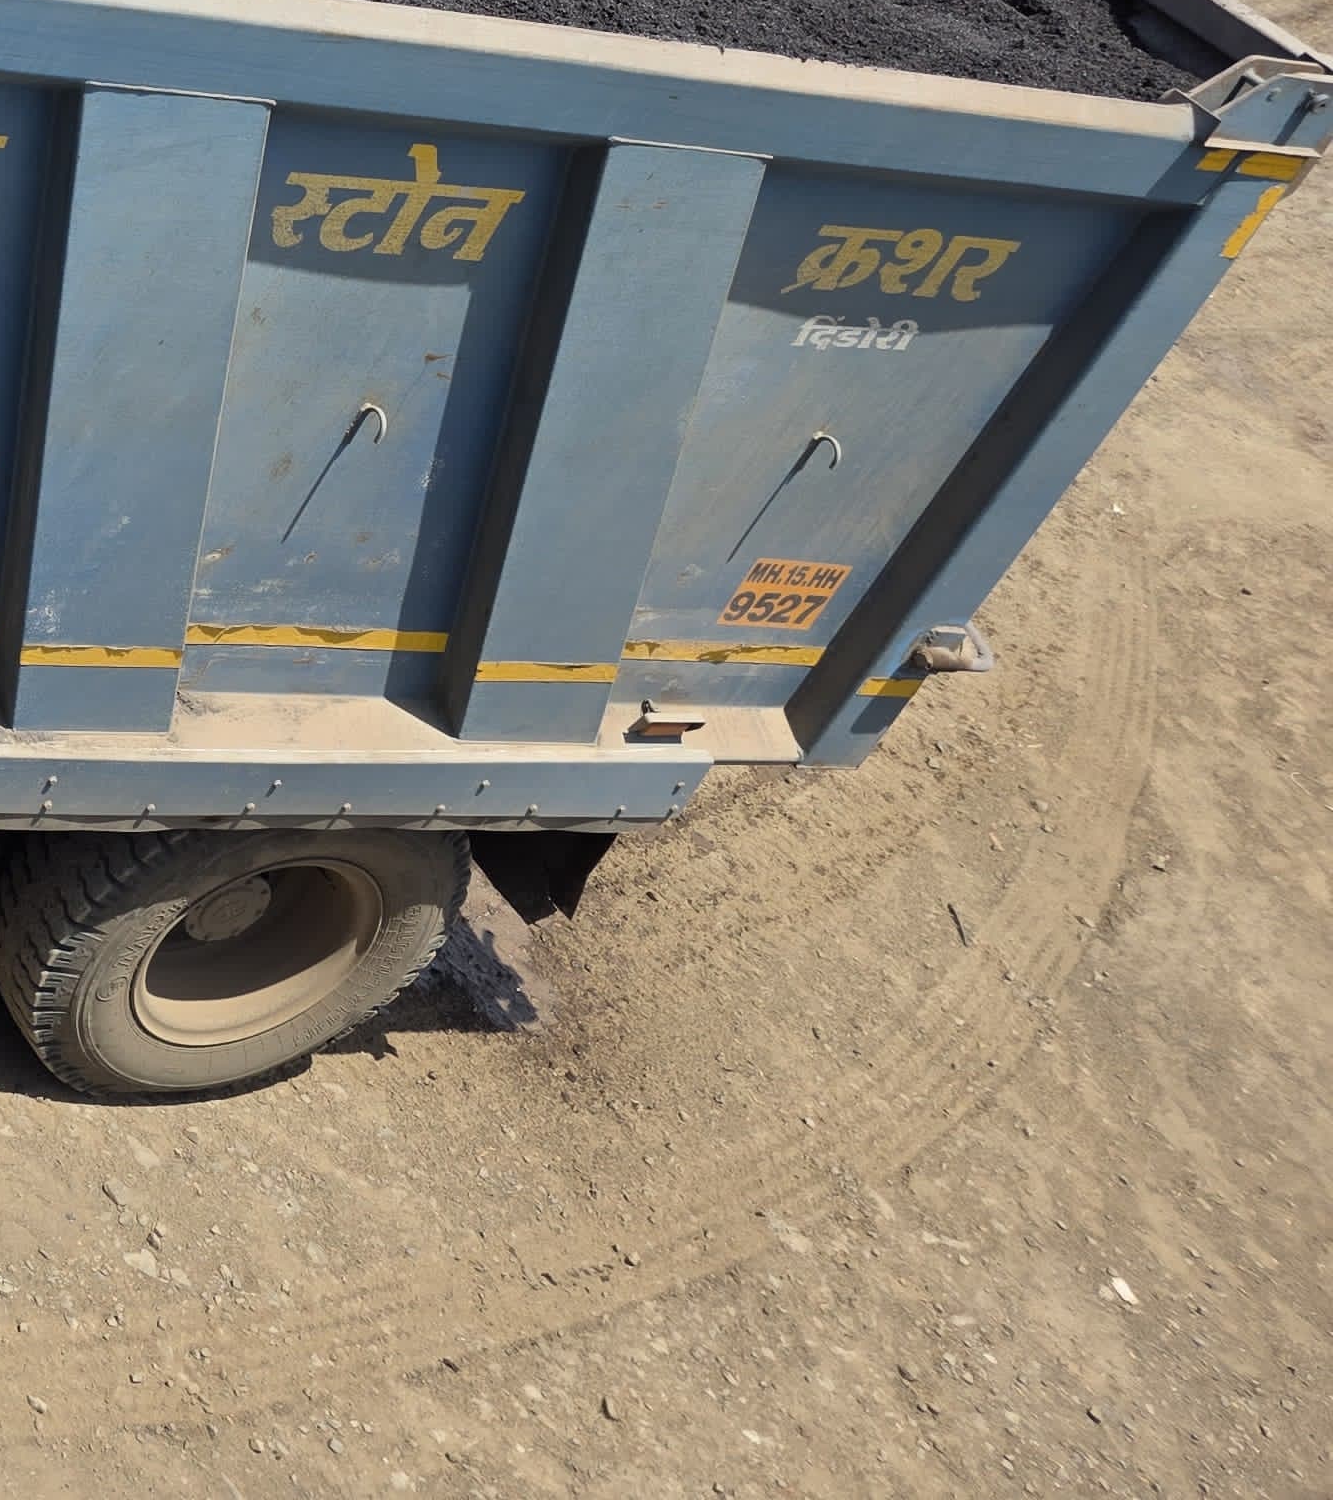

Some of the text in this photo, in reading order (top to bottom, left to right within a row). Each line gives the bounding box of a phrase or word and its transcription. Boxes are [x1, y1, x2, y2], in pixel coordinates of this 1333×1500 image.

[270, 143, 526, 262] स्टोन
[780, 224, 1022, 302] क्रशर
[789, 315, 920, 351] दिंडोरी
[746, 562, 846, 590] MH.15.HH
[723, 590, 829, 625] 9527
